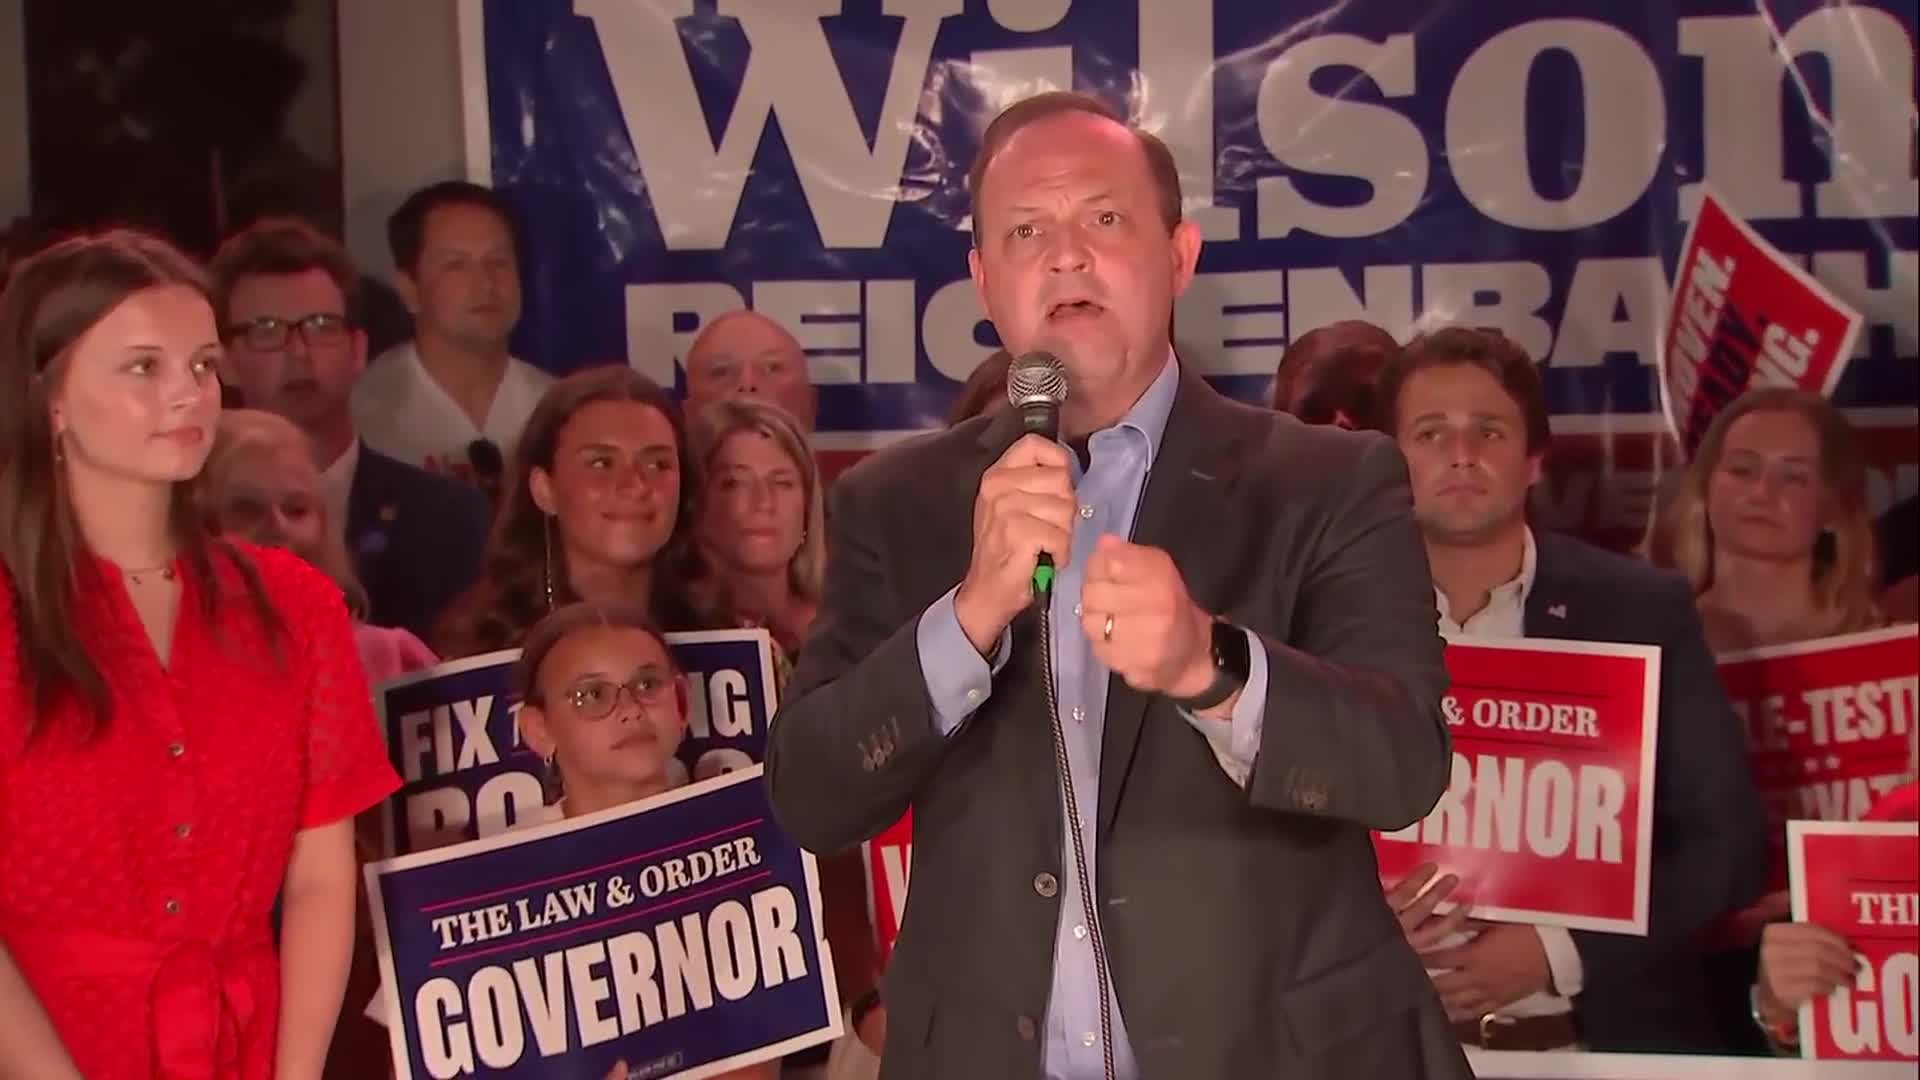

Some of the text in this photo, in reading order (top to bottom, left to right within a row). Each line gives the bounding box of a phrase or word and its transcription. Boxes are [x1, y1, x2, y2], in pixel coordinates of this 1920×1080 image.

[625, 250, 1918, 387] REICENBAH
[401, 694, 500, 782] FIX
[1440, 695, 1600, 738] & ORDER
[433, 835, 762, 950] THE LAW & ORDER
[415, 885, 809, 1080] GOVERNOR
